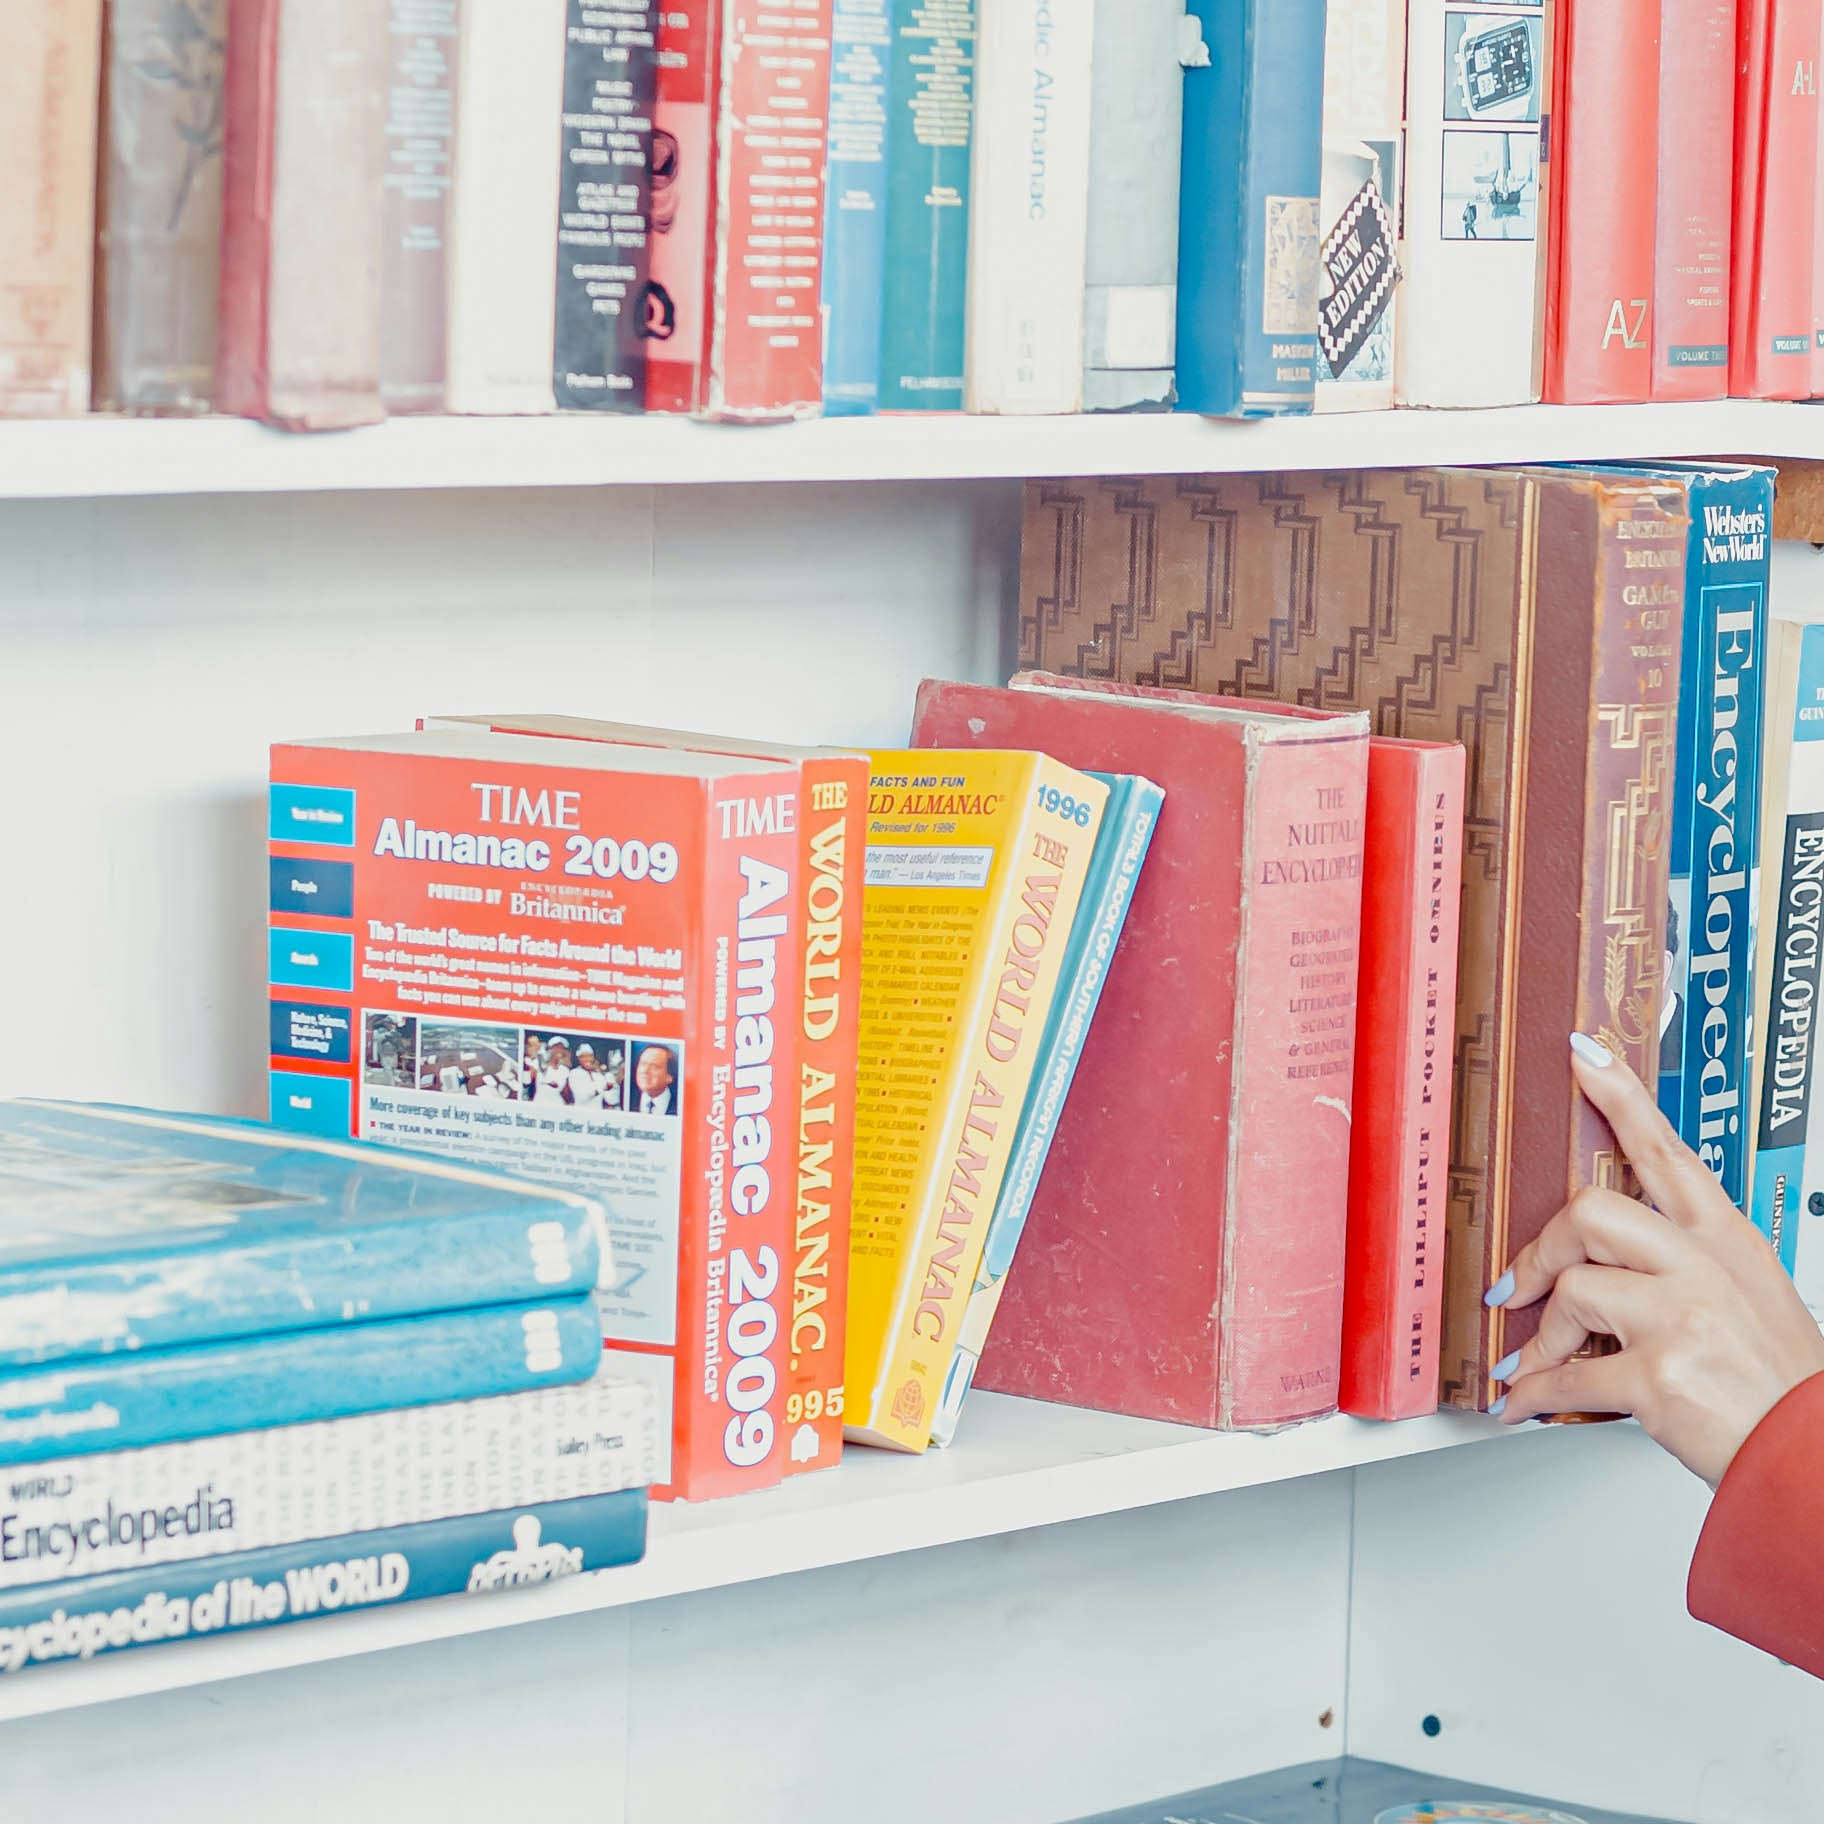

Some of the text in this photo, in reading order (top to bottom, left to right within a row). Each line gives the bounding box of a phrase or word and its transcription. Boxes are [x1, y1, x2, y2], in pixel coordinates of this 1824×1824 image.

[1790, 59, 1818, 96] A-L
[1024, 69, 1054, 223] Almanac
[1325, 236, 1388, 328] EDITION
[1328, 231, 1365, 286] NEW
[1702, 503, 1767, 538] Webster's
[470, 781, 582, 832] TIME
[811, 780, 850, 812] THE
[869, 776, 967, 788] FACTS AND FUN
[897, 793, 998, 816] ALMANAC
[1036, 783, 1093, 830] 1996
[1316, 787, 1345, 810] THE
[716, 792, 797, 841] TIME
[372, 816, 681, 884] Almanac 2009
[884, 852, 910, 865] most
[910, 851, 938, 866] useful
[939, 852, 985, 866] reference
[1030, 832, 1070, 868] THE
[910, 869, 982, 883] Los Angeles Times
[1690, 600, 1755, 1180] Encyclopedia
[508, 892, 626, 926] Britannica
[805, 815, 847, 1043] WORLD
[984, 871, 1064, 1064] WORLD
[1409, 791, 1448, 1383] THE LILLIPUT POCKET OMNIBUS
[369, 1096, 667, 1143] More coverage of key subjects than any other leading almanac
[723, 852, 793, 1468] Almanac 2009
[910, 1070, 1005, 1345] ALMANAC
[1, 1481, 236, 1565] Encyclopedia
